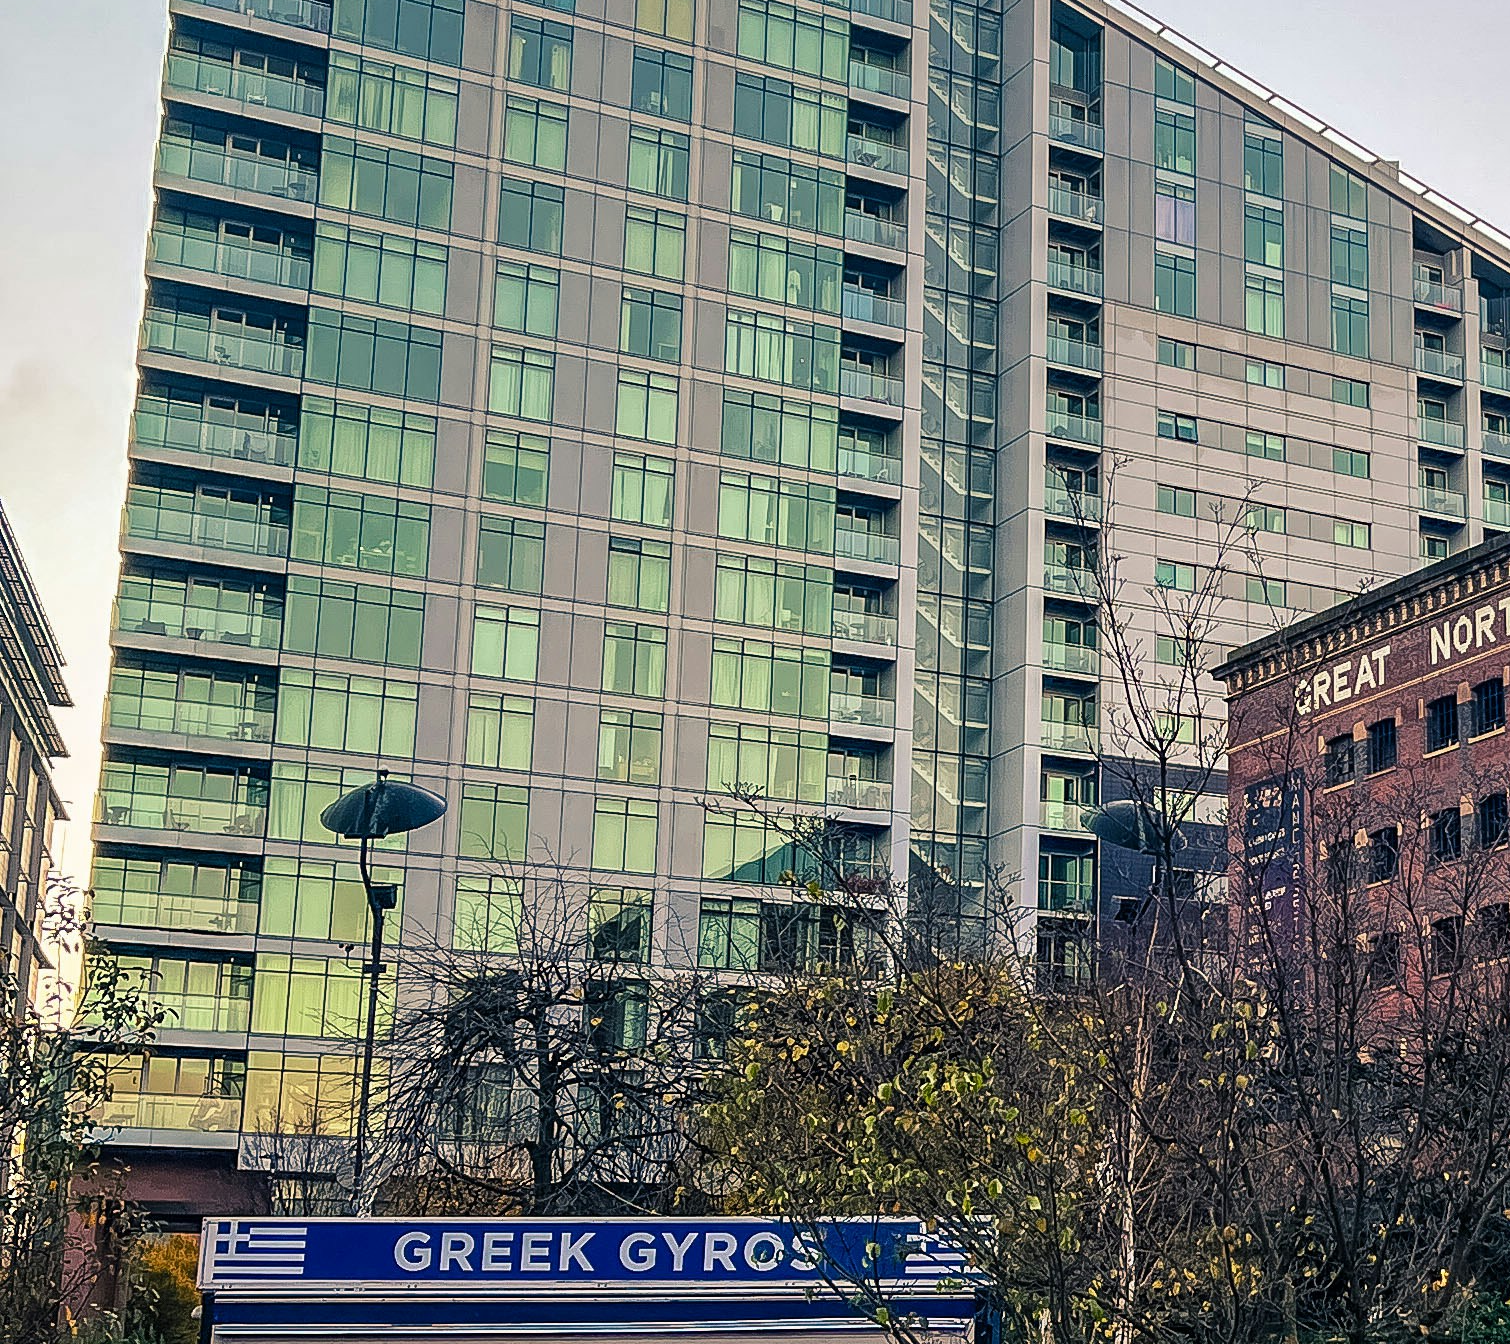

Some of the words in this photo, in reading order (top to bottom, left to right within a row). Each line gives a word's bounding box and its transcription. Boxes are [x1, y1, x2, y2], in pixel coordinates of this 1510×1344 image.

[1295, 645, 1391, 715] GREAT
[394, 1232, 596, 1272] GREEK
[619, 1231, 823, 1272] GYROS
